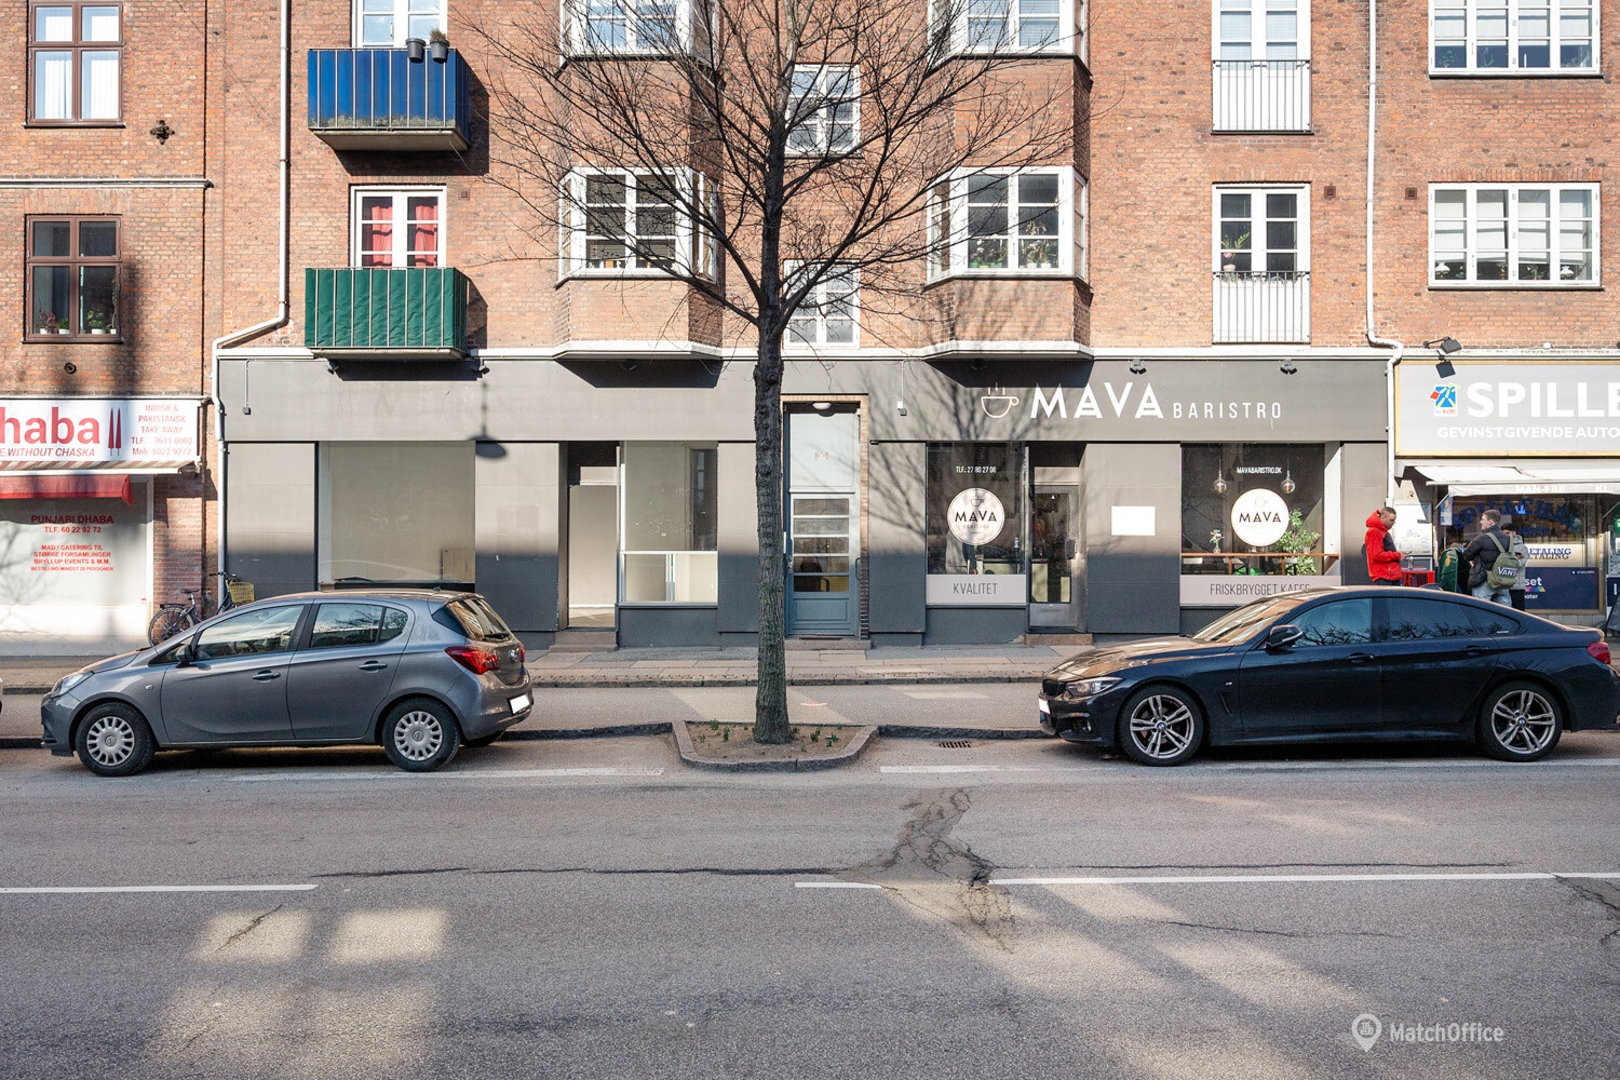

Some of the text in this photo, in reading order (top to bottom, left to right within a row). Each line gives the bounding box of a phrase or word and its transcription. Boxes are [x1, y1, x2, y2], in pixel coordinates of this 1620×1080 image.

[1030, 382, 1282, 419] MAVA BARISTRO
[1466, 381, 1620, 418] SPILLE
[0, 407, 100, 444] haba
[1437, 426, 1573, 439] GEVINSTGIVENDE
[8, 448, 53, 457] WITHOUT
[55, 448, 95, 457] CHASKA
[1515, 484, 1613, 493] MAN-FRE KL.
[31, 515, 114, 524] PUNJABI DHABA
[954, 510, 997, 522] MAVA
[1239, 512, 1281, 523] MAVA
[1497, 566, 1518, 577] VANS
[953, 583, 998, 595] KVALITET
[1210, 583, 1278, 595] FRISKBRYGGET
